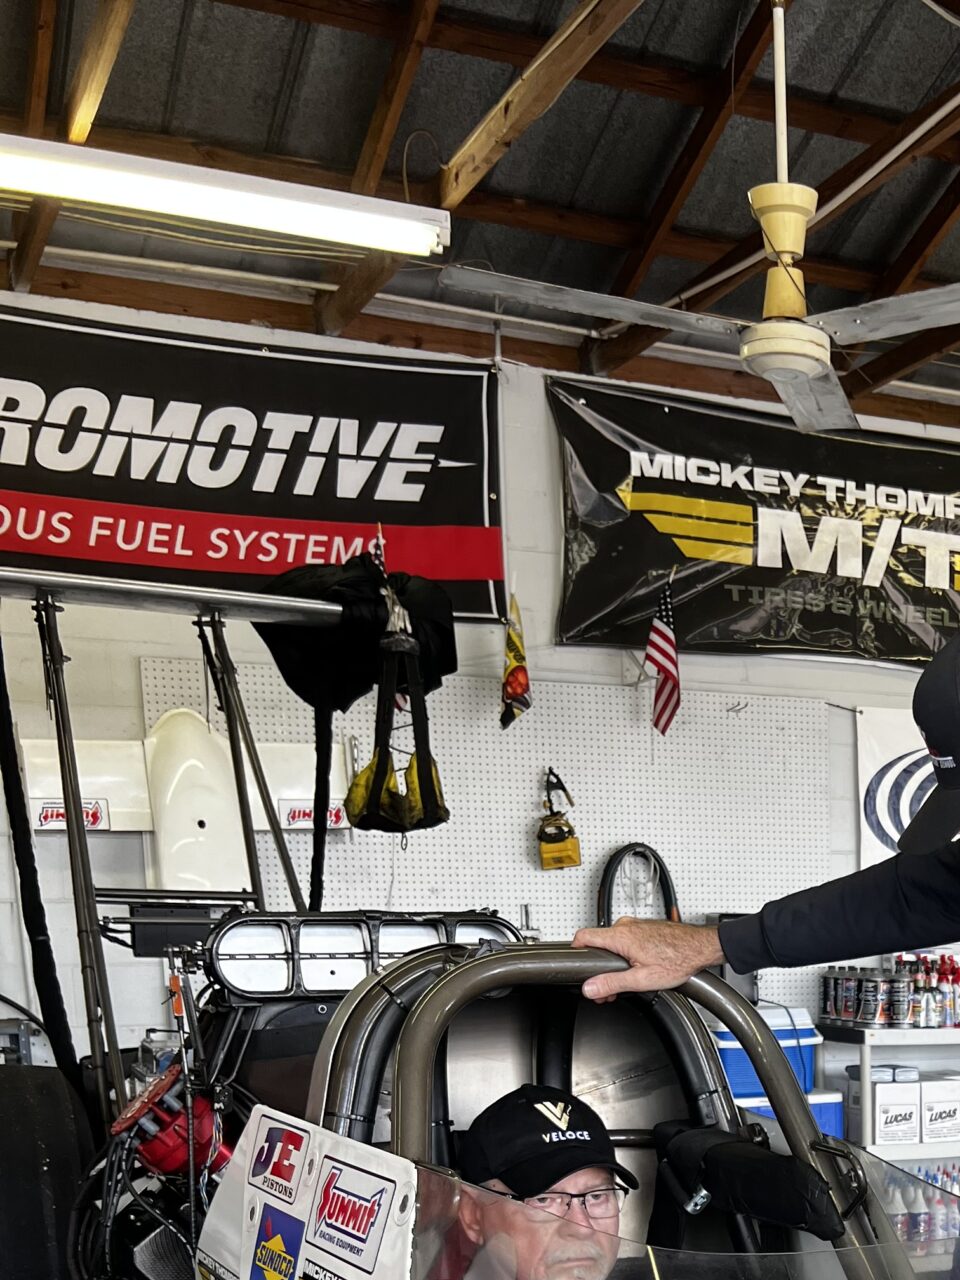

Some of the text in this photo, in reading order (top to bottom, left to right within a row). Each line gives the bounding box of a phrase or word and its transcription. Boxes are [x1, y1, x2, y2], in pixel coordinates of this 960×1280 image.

[629, 450, 811, 496] MICKEY
[89, 516, 193, 557] FUEL
[884, 1111, 914, 1126] LUCAS
[928, 1108, 958, 1123] LUCAS
[542, 1130, 592, 1143] VELOCE
[251, 1127, 305, 1184] JE
[262, 1175, 294, 1199] PISTONS
[318, 1229, 365, 1257] RACING EQUIPMENT
[256, 1242, 294, 1279] SUNOCO
